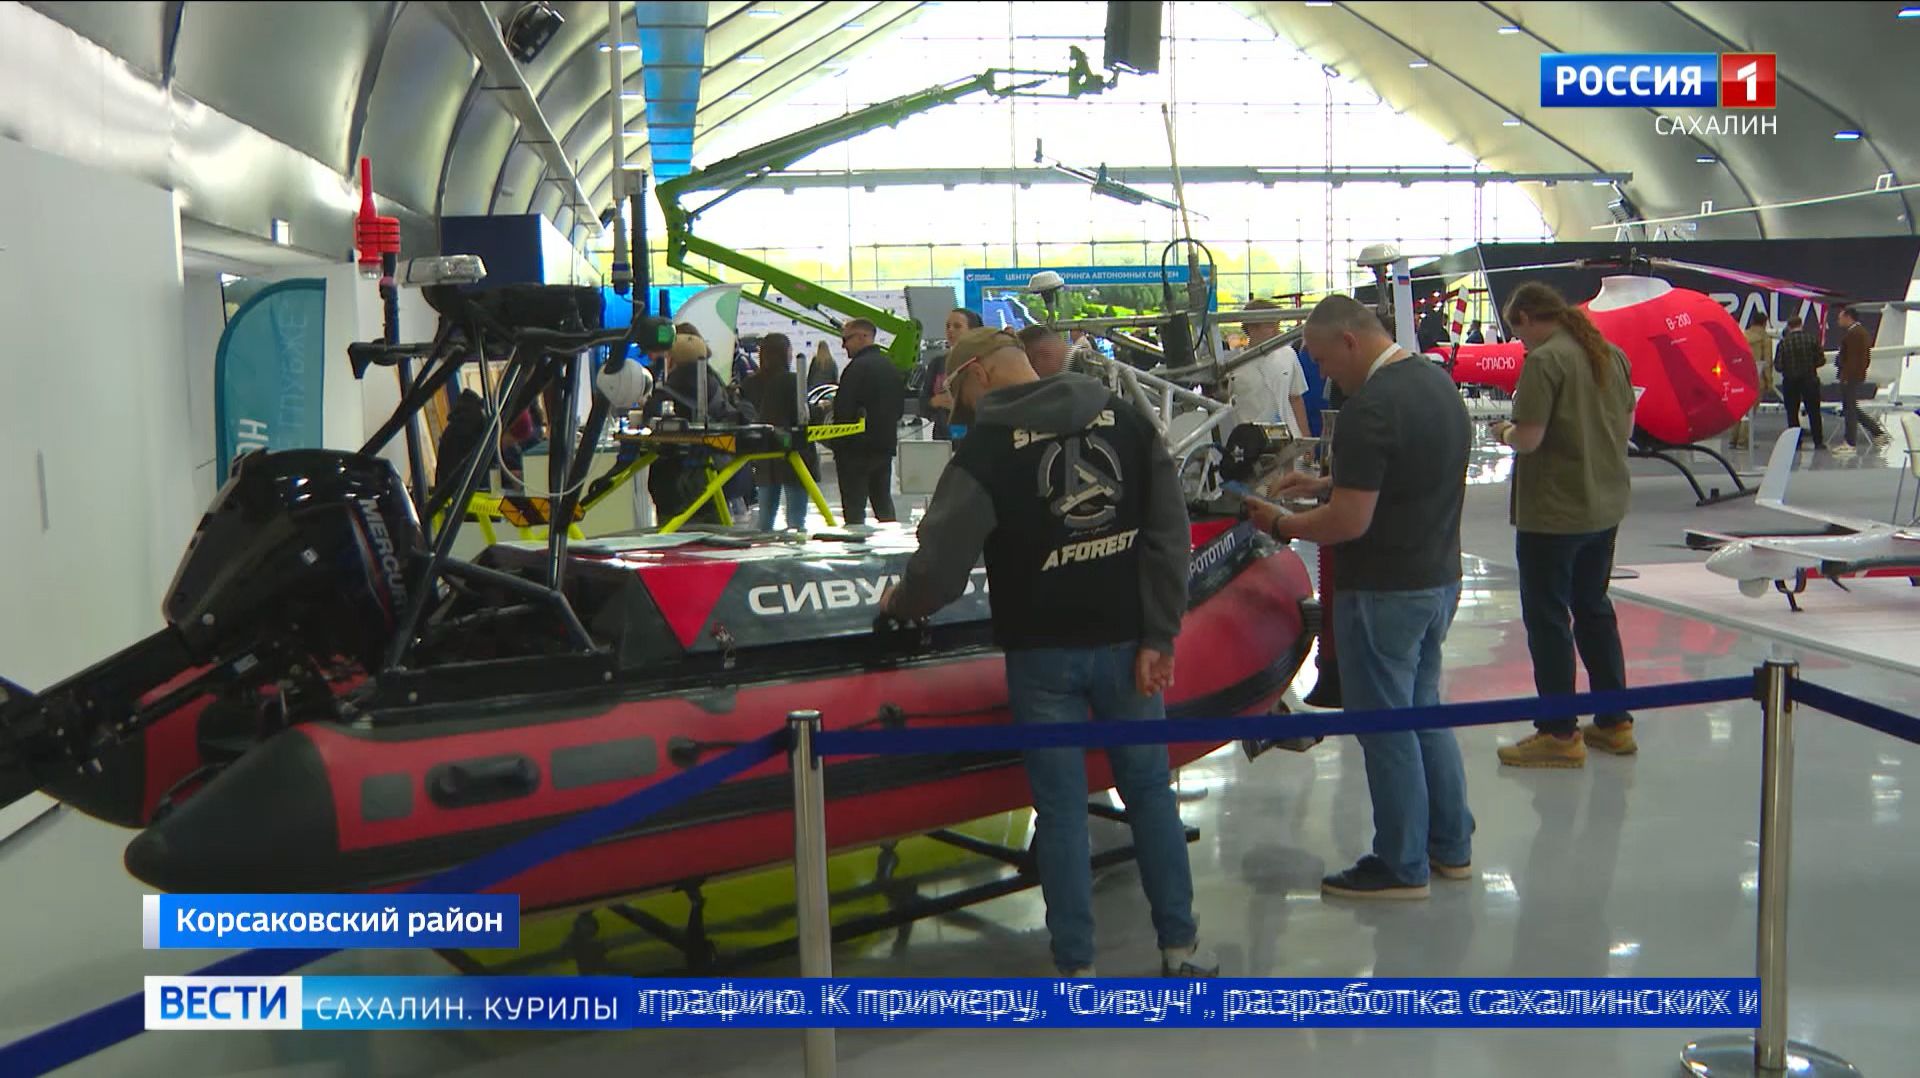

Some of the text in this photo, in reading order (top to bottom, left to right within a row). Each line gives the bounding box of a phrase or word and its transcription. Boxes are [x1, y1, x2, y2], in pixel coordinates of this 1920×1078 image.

[1060, 271, 1091, 280] ОРИНГА
[1092, 271, 1147, 280] АВТОНОМНЫХ
[1148, 270, 1179, 279] СИСЕМ
[1187, 532, 1236, 581] РОТОТИП
[748, 574, 902, 616] СИВУ
